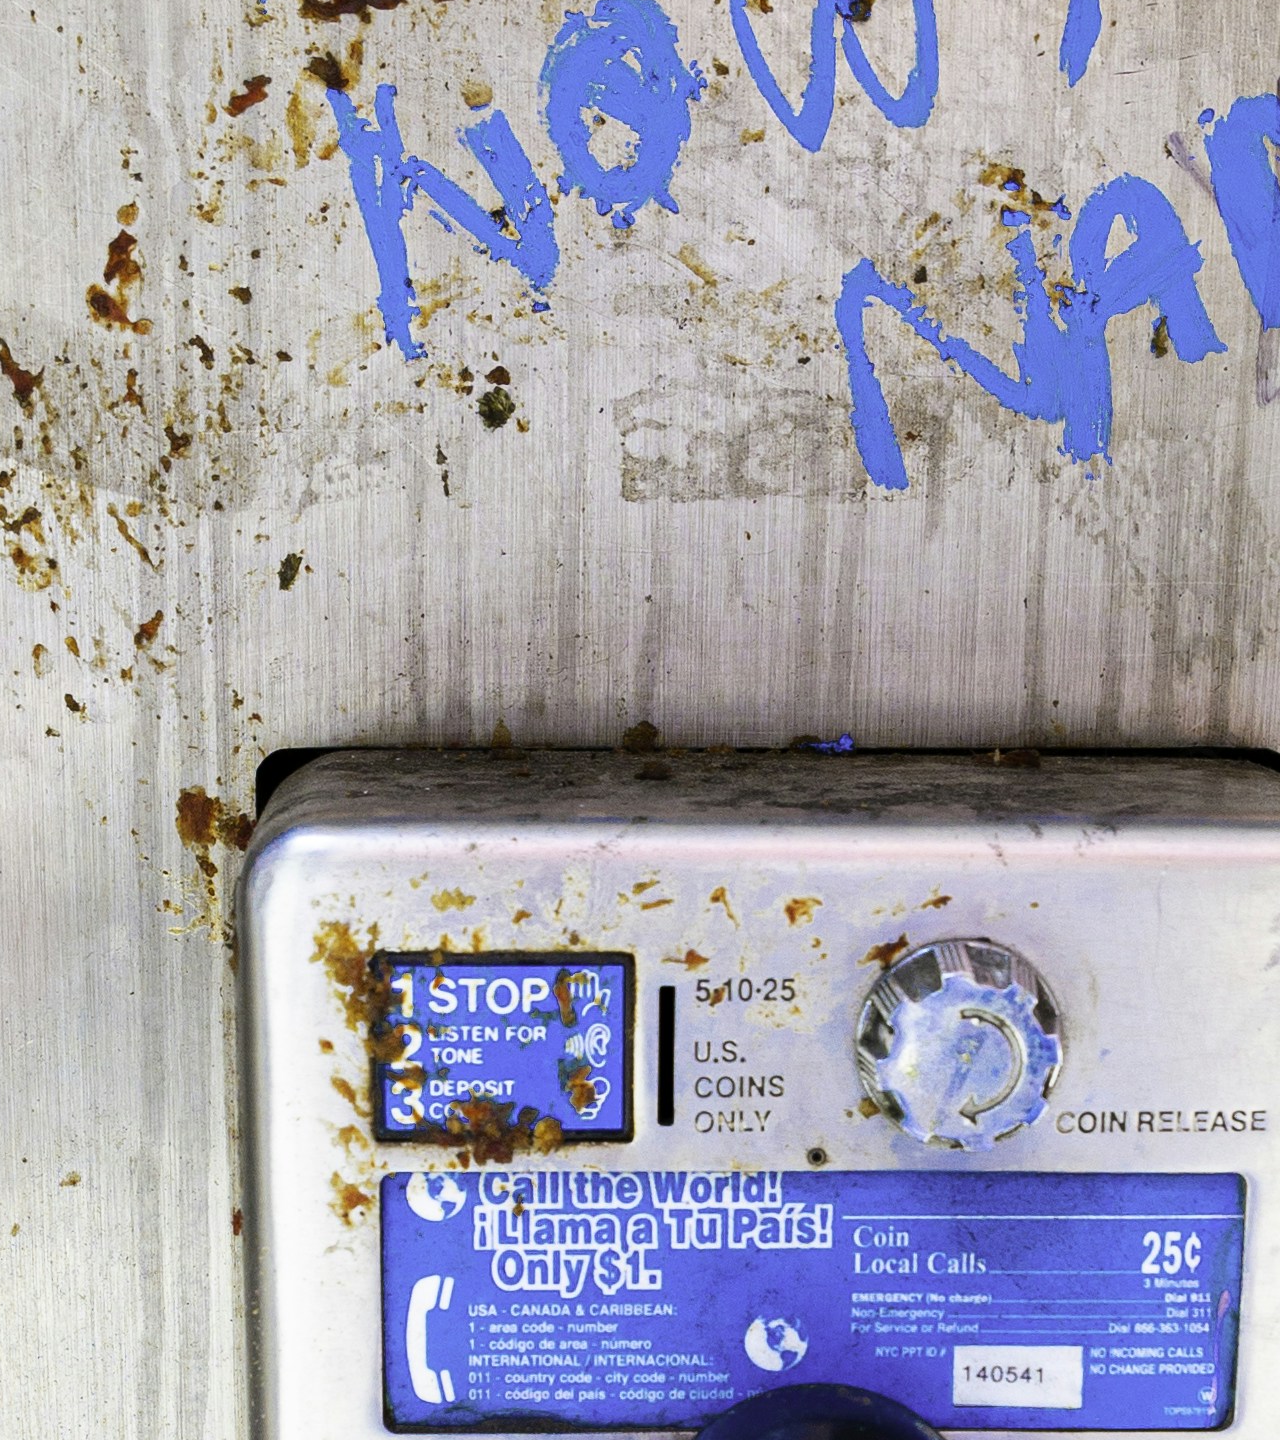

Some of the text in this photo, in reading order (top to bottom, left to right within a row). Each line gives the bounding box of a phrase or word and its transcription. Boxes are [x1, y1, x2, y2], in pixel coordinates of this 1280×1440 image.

[428, 976, 550, 1015] STOP
[428, 1026, 499, 1042] LISTEN
[505, 1026, 547, 1042] FOR
[431, 1047, 484, 1065] TONE
[693, 1041, 747, 1063] U.S.
[429, 1080, 516, 1097] DEPOSIT
[694, 1076, 785, 1098] COINS
[694, 1110, 772, 1134] ONLY
[1056, 1110, 1269, 1134] COIN RELEASE
[478, 1171, 783, 1208] Call the World!
[627, 1213, 659, 1250] a
[667, 1208, 723, 1250] Tu
[728, 1203, 833, 1249] País!
[853, 1225, 909, 1248] Coin
[1140, 1231, 1202, 1274] 25¢
[853, 1251, 987, 1274] Local Calls
[491, 1248, 663, 1299] Only $1.
[1154, 1278, 1199, 1289] Minutes
[851, 1293, 923, 1303] EMERGENCY
[1165, 1292, 1187, 1303] Dial
[468, 1304, 677, 1317] USA CANADA & CARIBBEAN:
[851, 1307, 945, 1320] Non-Emergency
[1166, 1307, 1211, 1318] Dial 311
[489, 1323, 518, 1334] area
[522, 1321, 554, 1333] code
[567, 1321, 618, 1333] number
[851, 1321, 979, 1333] For Service or Refund
[1108, 1322, 1130, 1334] Dial
[489, 1337, 535, 1353] código
[538, 1338, 555, 1350] de
[559, 1339, 588, 1350] area
[468, 1355, 581, 1367] INTERNATIONAL
[875, 1346, 899, 1357] NYC
[902, 1346, 923, 1357] PPT
[963, 1365, 1046, 1384] 140541
[1090, 1346, 1106, 1358] NO
[1109, 1346, 1165, 1358] INCOMING
[1167, 1346, 1204, 1358] CALLS
[1090, 1363, 1216, 1375] NO CHANGE PROVIDED
[468, 1370, 731, 1386] 011 country code city code number
[468, 1388, 490, 1401] 011
[504, 1388, 550, 1403] código
[554, 1388, 574, 1401] del
[578, 1388, 606, 1403] país
[619, 1387, 665, 1403] código
[669, 1387, 685, 1400] de
[689, 1386, 734, 1401] ciudad
